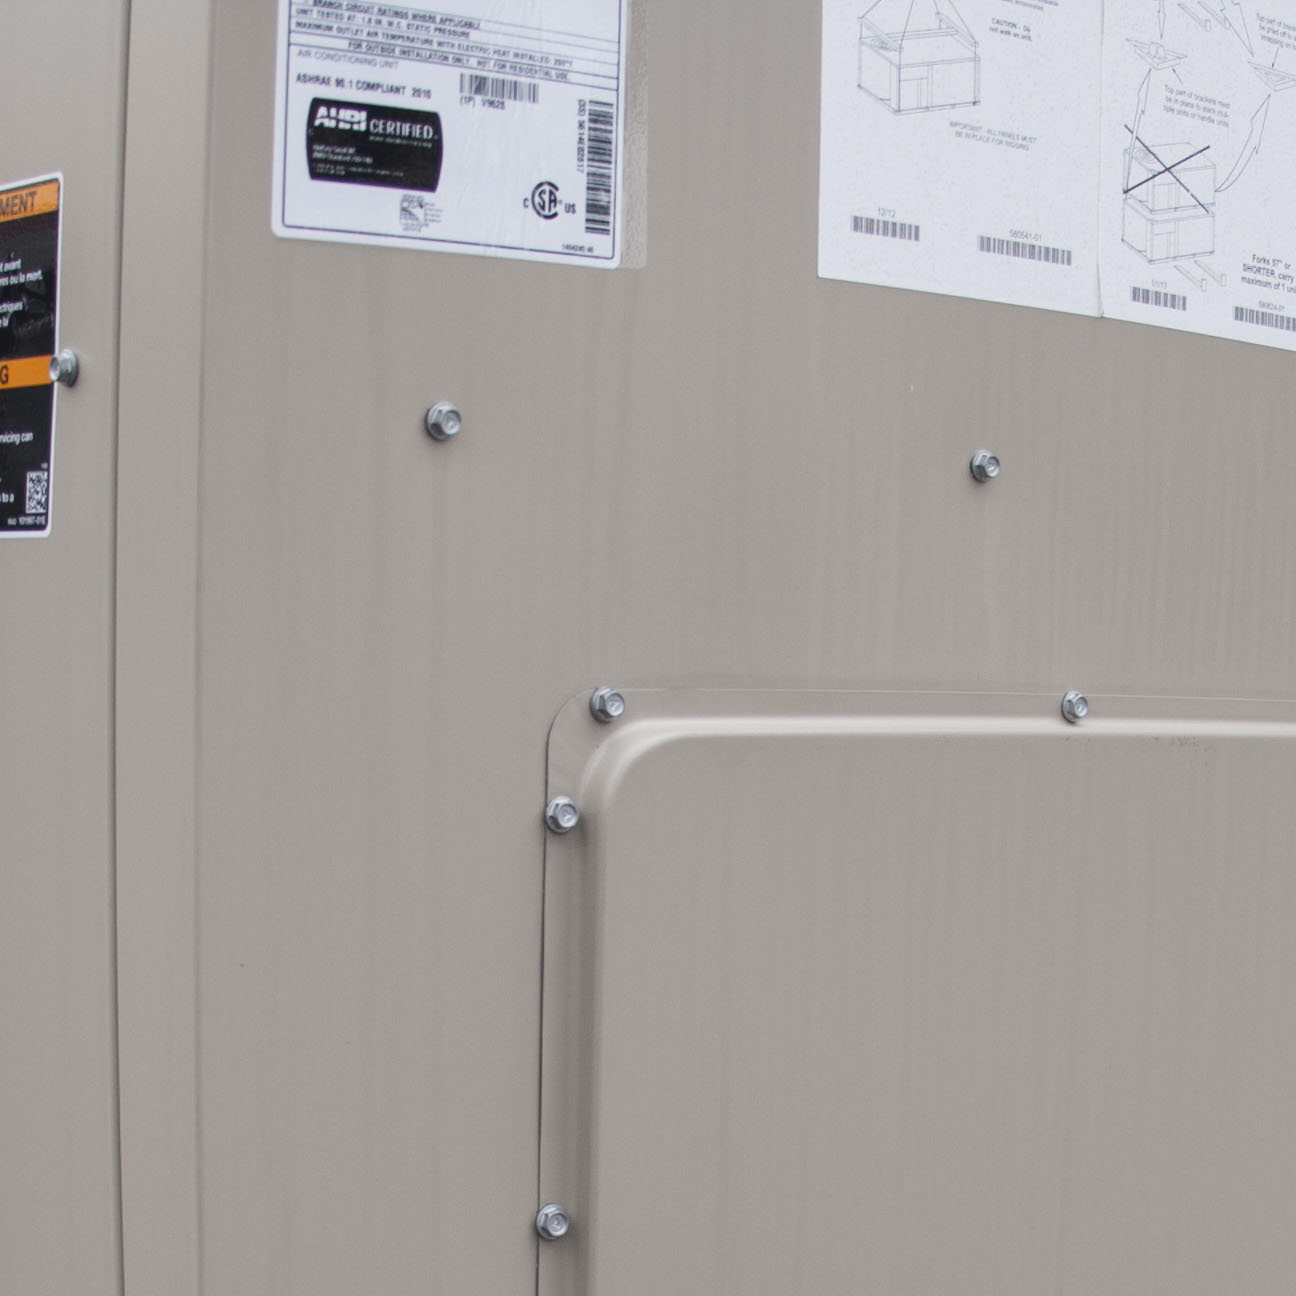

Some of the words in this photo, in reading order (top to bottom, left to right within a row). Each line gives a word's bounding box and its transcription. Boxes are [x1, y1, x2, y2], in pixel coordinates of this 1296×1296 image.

[355, 80, 406, 95] COMPLIANT
[369, 119, 434, 140] CERTIFIED
[564, 203, 577, 215] US
[1251, 253, 1271, 266] Forks
[1284, 261, 1292, 270] or
[1240, 275, 1272, 290] maximum
[1273, 280, 1281, 290] of
[1278, 270, 1294, 285] carry
[21, 431, 33, 442] can
